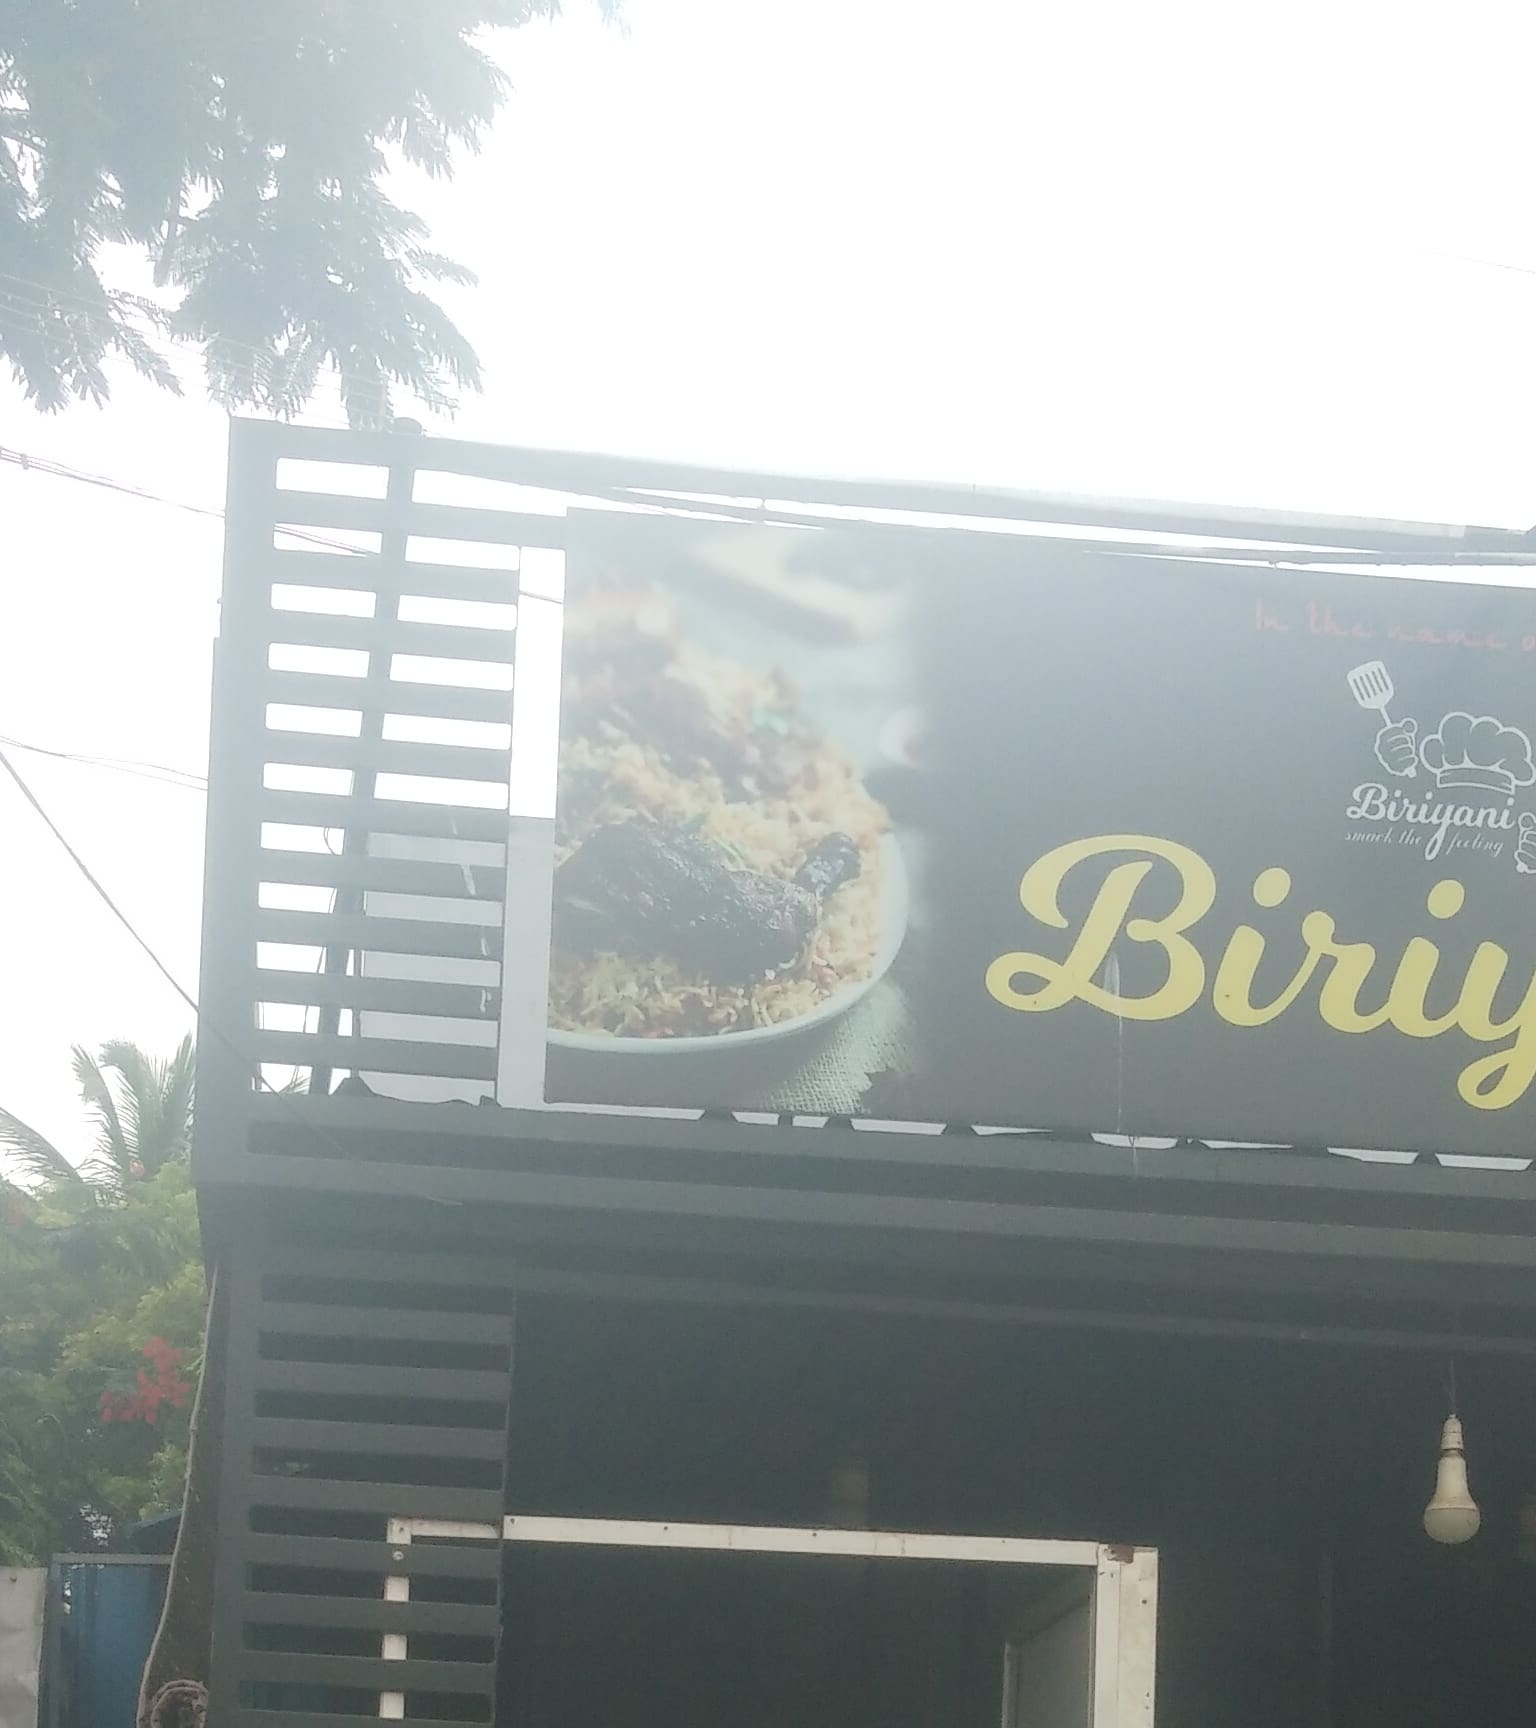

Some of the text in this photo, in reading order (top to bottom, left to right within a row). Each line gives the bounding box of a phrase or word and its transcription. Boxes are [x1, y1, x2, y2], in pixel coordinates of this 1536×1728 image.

[1307, 601, 1372, 638] the
[1386, 623, 1508, 650] name
[1345, 782, 1516, 861] Biriyani
[1398, 828, 1423, 847] the
